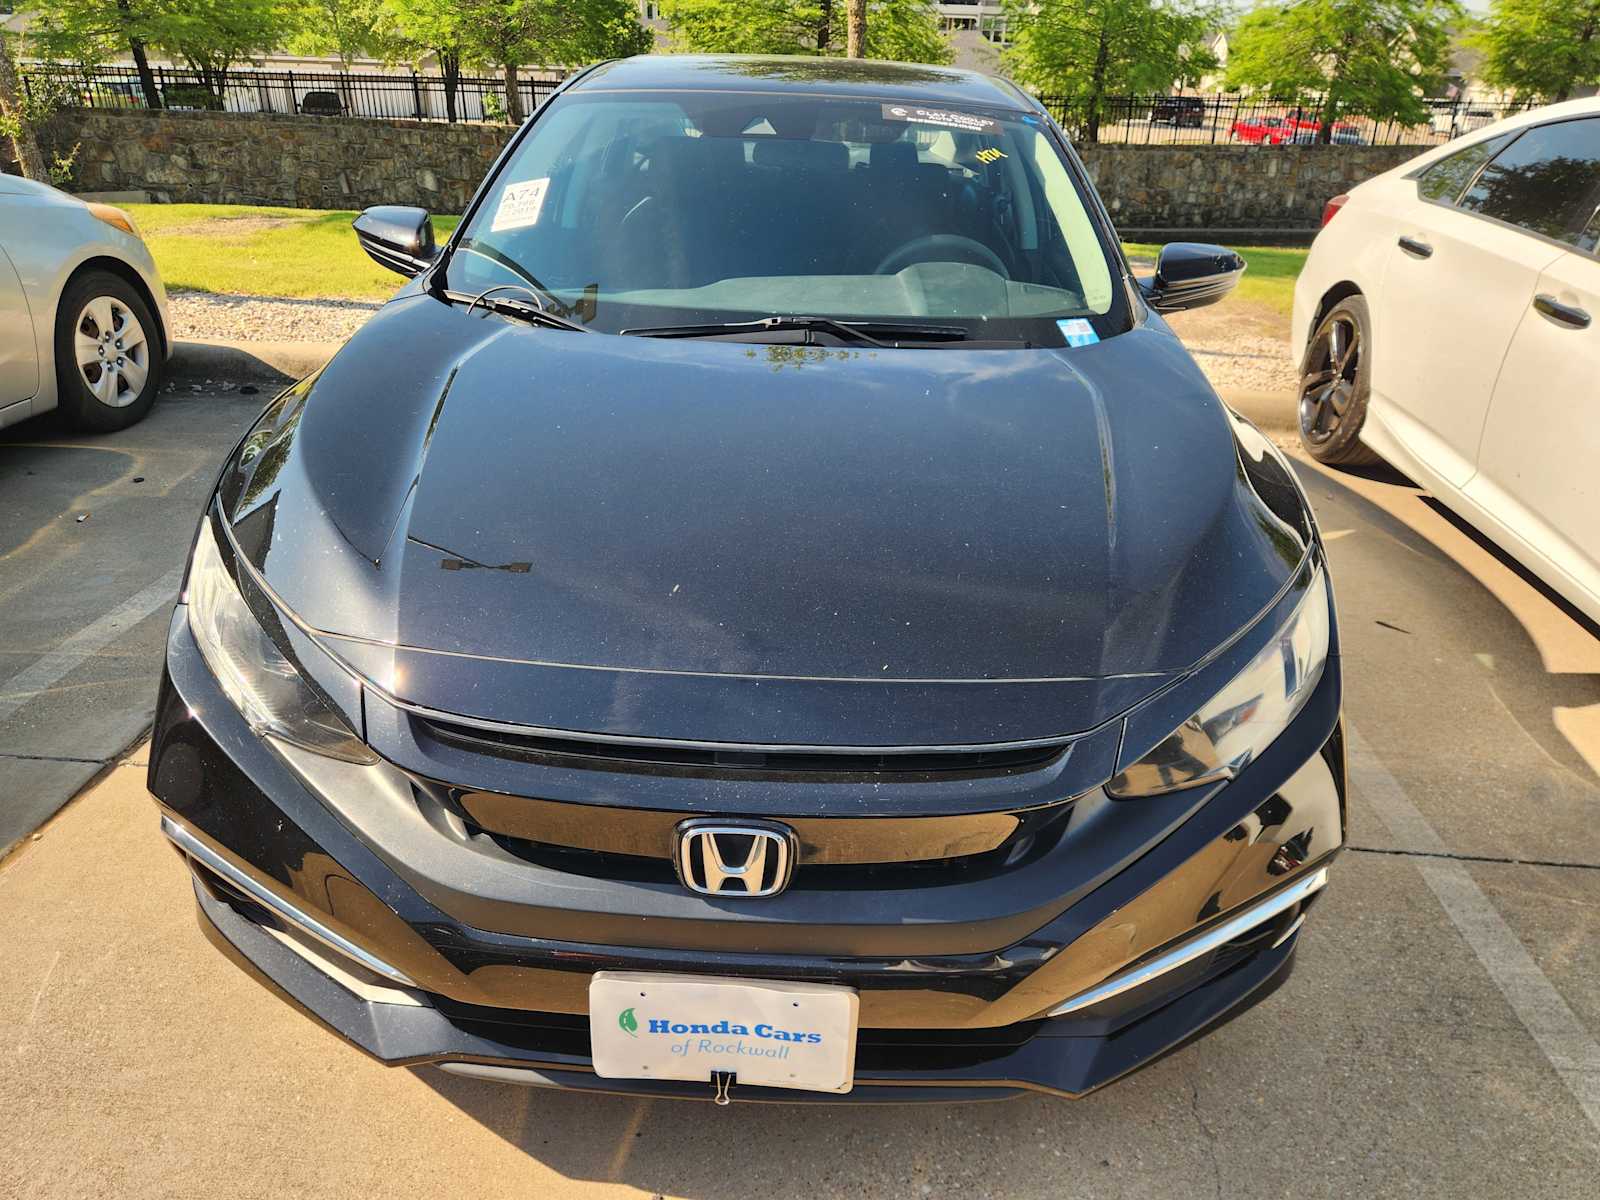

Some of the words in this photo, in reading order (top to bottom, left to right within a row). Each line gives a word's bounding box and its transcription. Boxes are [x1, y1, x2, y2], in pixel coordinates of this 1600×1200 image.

[648, 1019, 750, 1036] Honda
[754, 1023, 823, 1044] Cars
[671, 1039, 691, 1057] of
[698, 1039, 790, 1060] Rockwall
